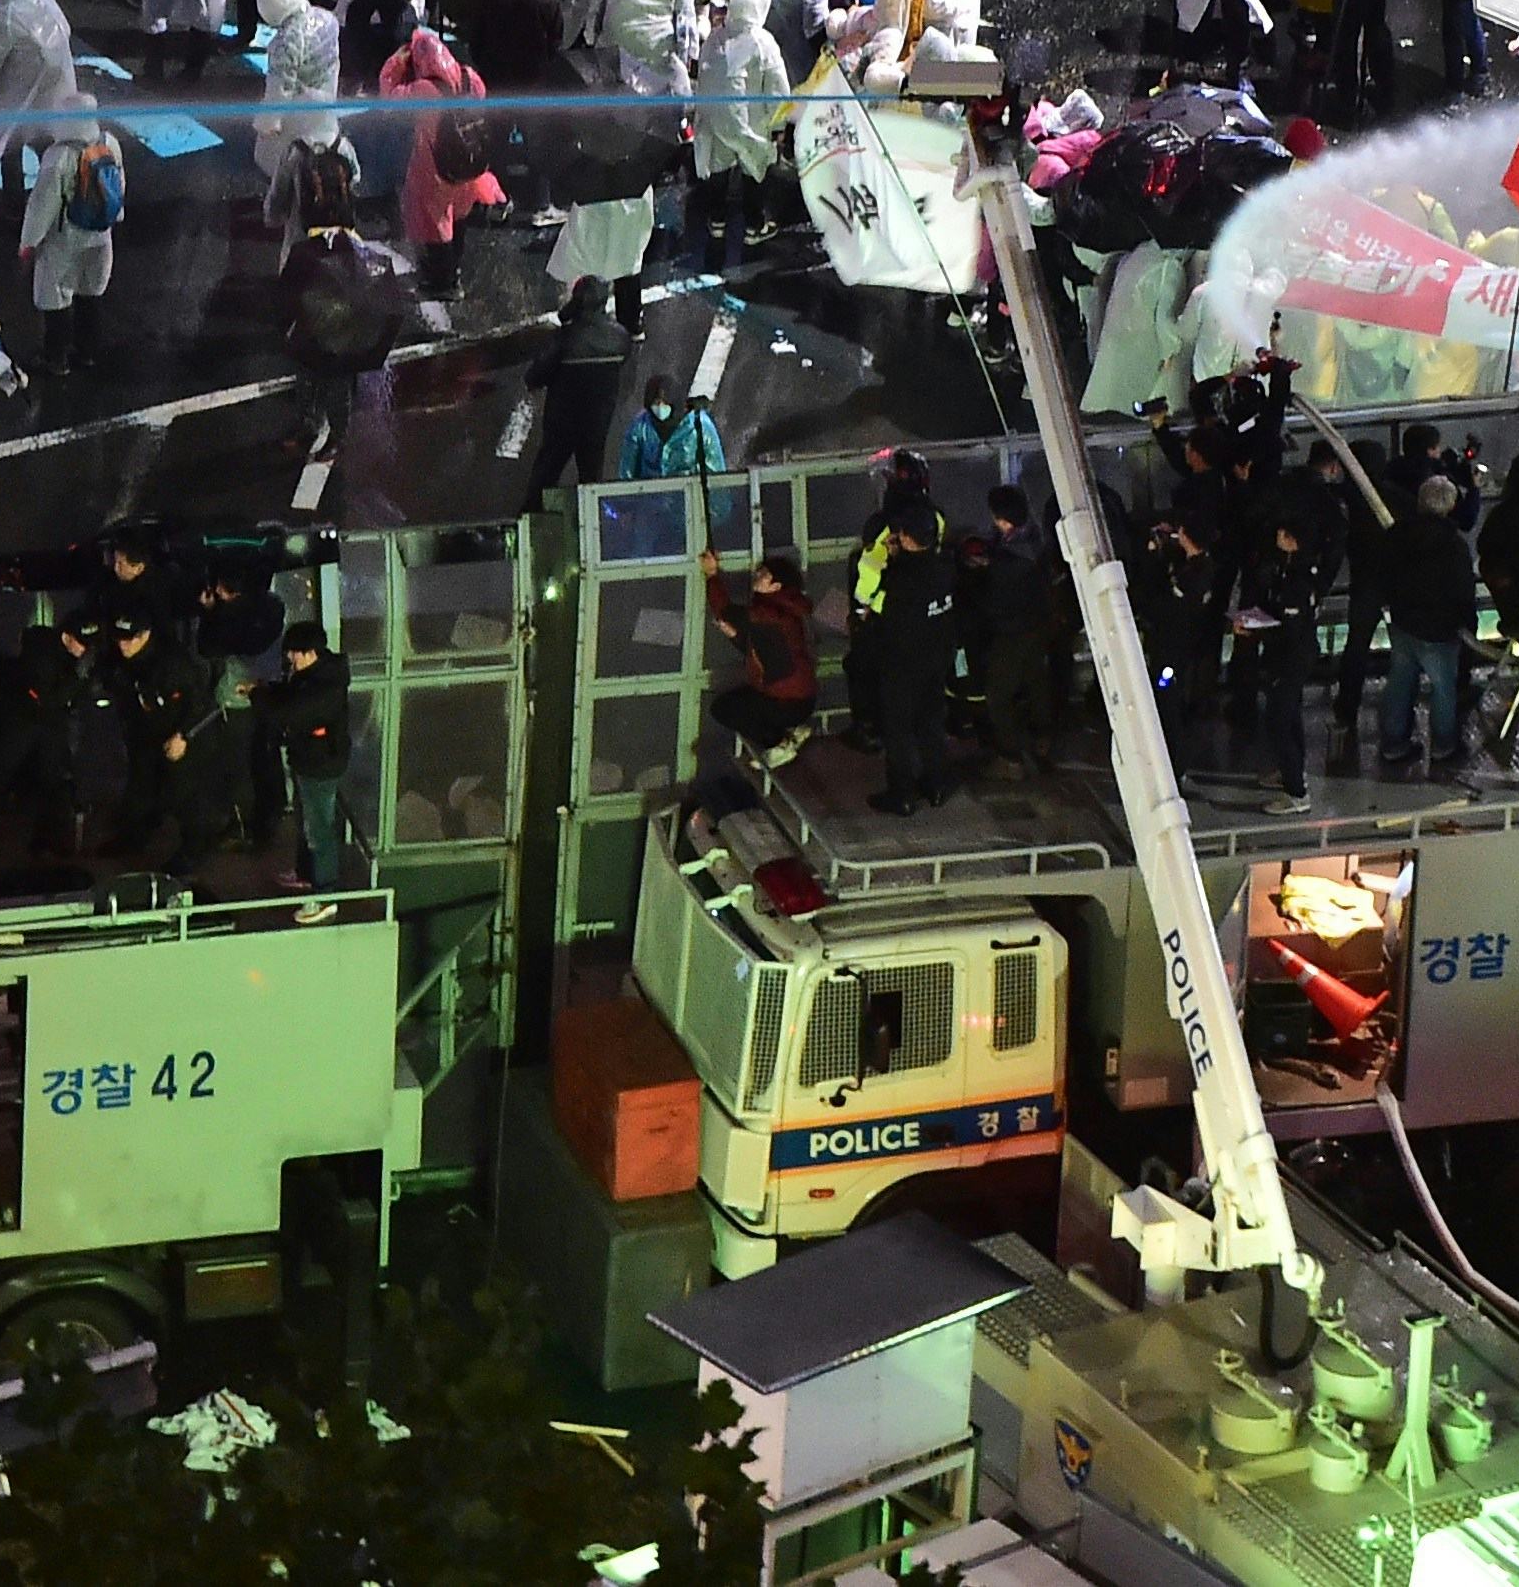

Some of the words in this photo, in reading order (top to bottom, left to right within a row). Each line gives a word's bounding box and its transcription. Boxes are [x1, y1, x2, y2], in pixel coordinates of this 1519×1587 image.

[1421, 932, 1511, 984] 경찰
[1162, 929, 1216, 1074] POLICE
[43, 1063, 136, 1115] 경찰
[150, 1051, 216, 1101] 42
[809, 1122, 921, 1159] POLICE
